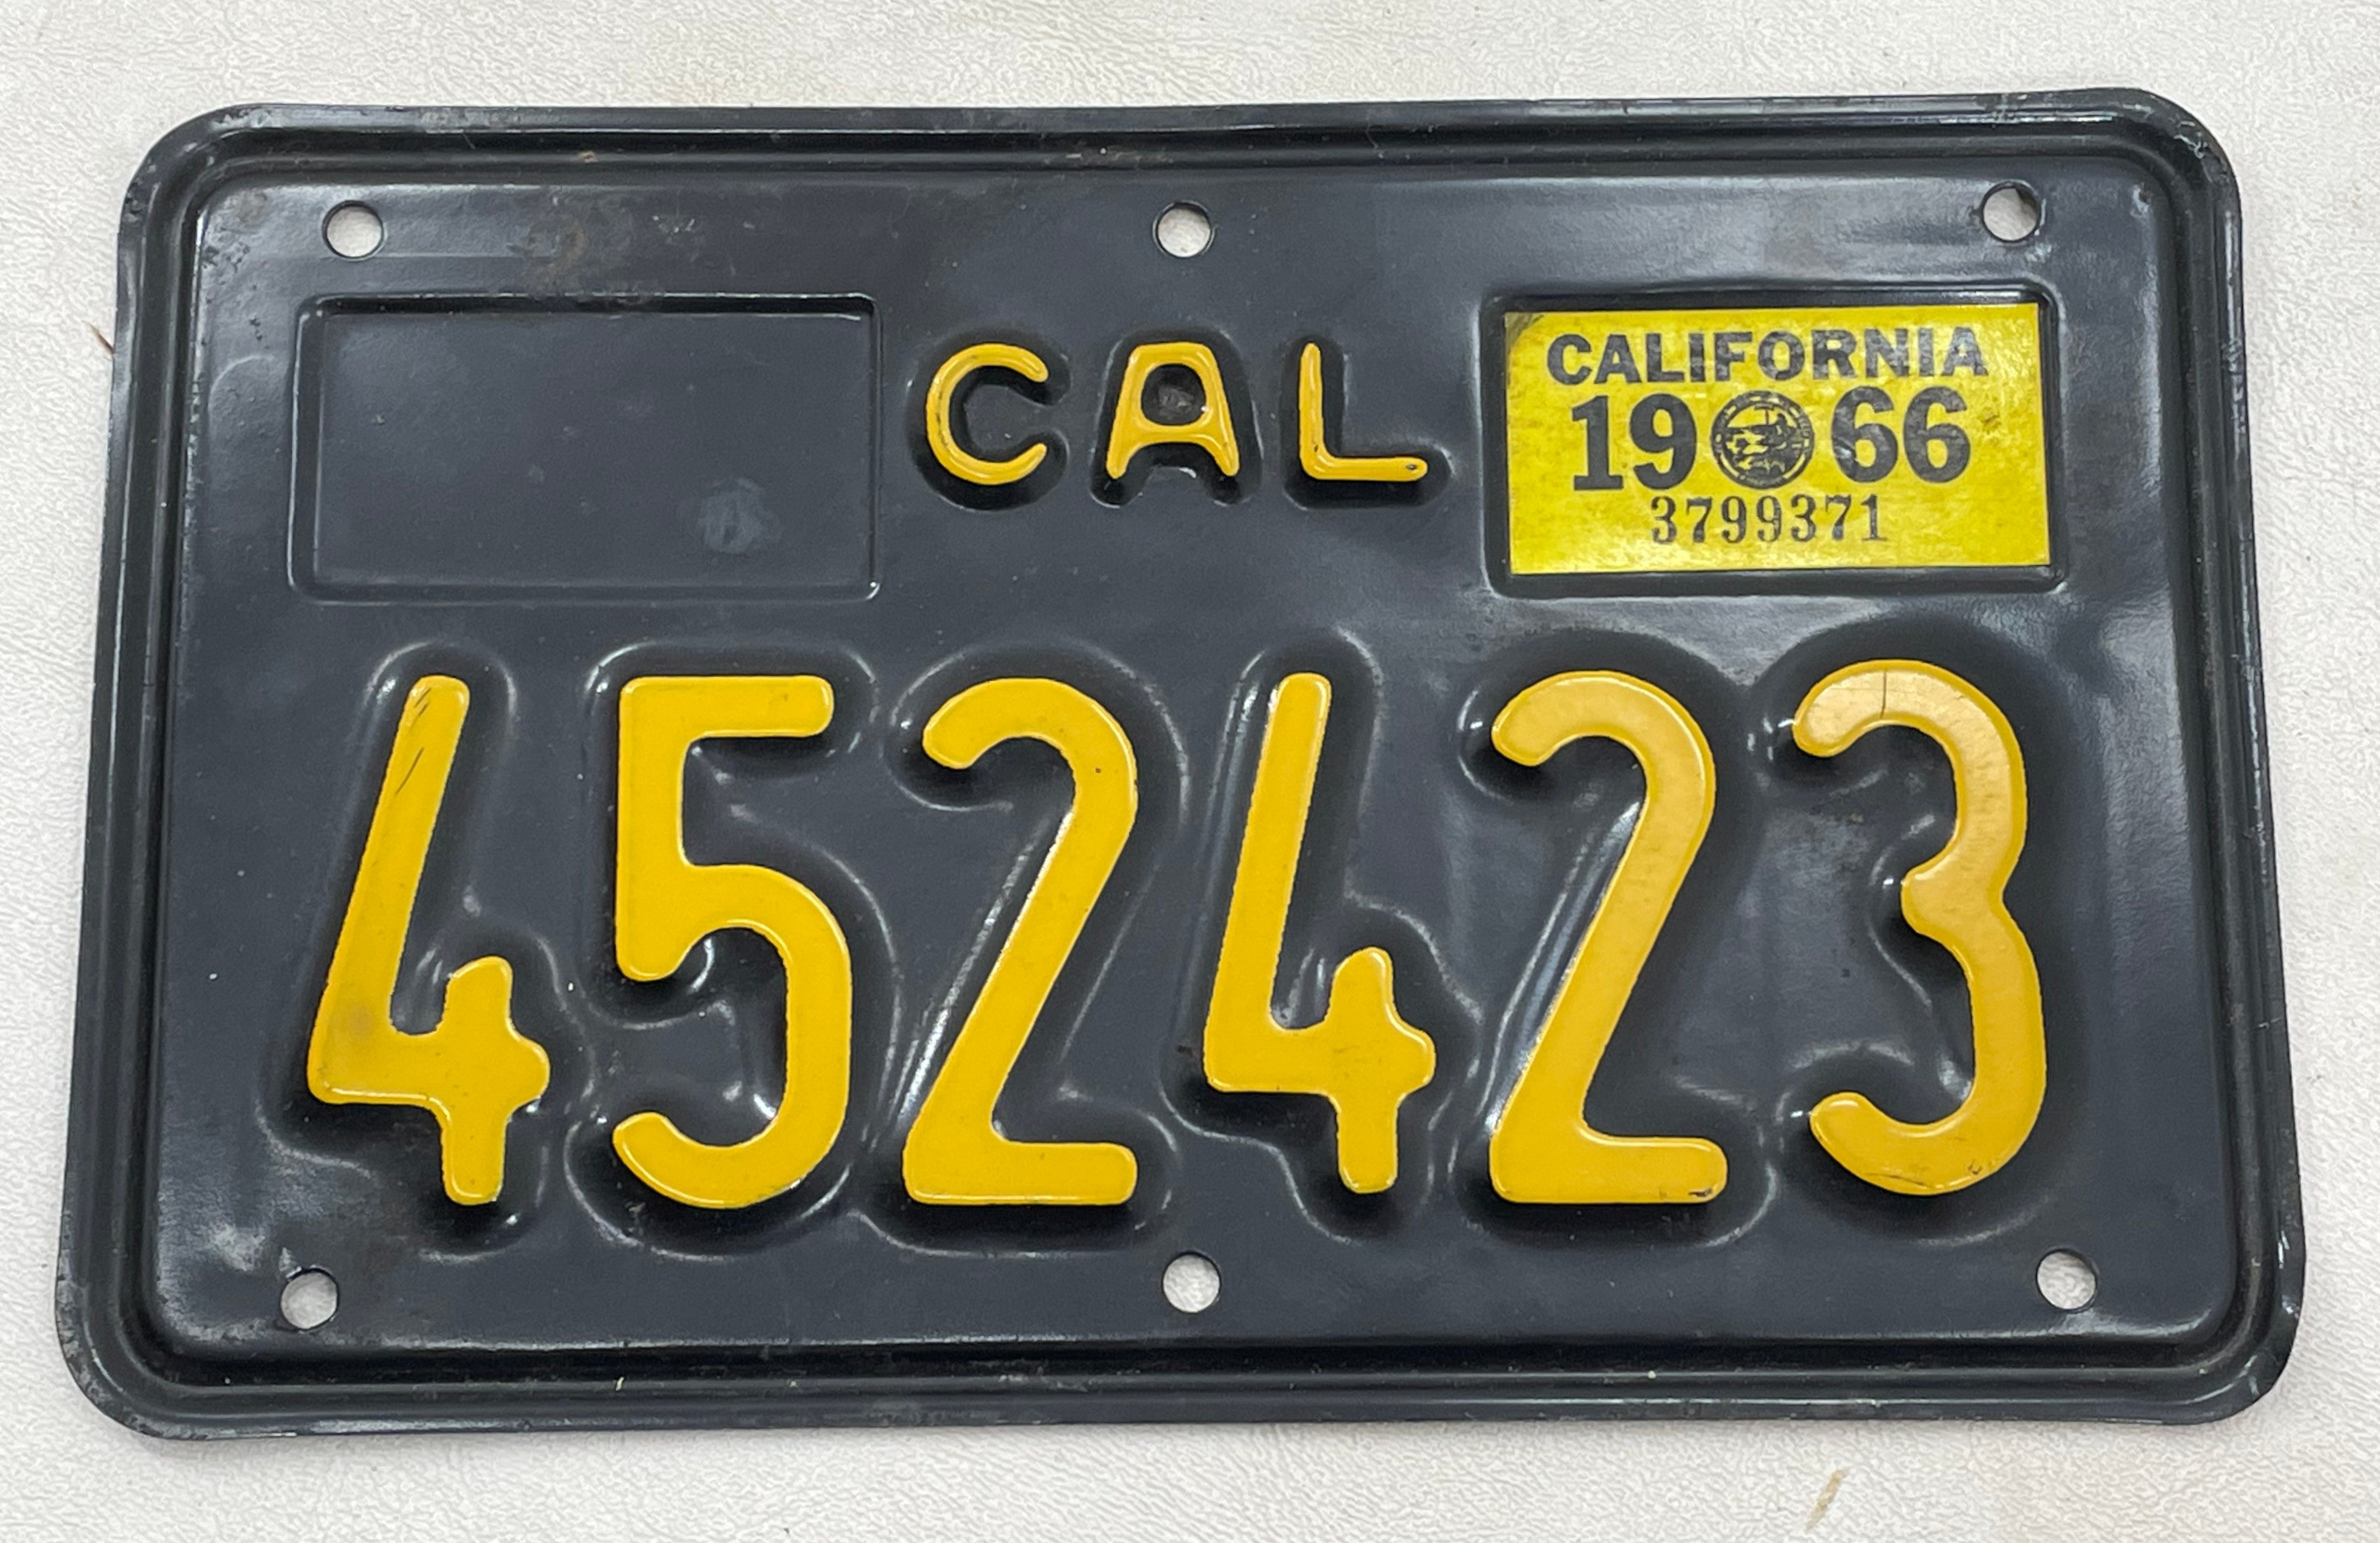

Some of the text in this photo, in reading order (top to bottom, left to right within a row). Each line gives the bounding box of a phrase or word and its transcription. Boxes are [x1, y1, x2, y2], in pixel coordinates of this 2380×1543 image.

[1545, 327, 1989, 386] CALIFORNIA
[925, 342, 1428, 485] CAL
[1571, 392, 1697, 492] 19
[1830, 386, 1971, 484] 66
[1650, 493, 1888, 545] 3799371
[308, 658, 2049, 1208] 452423
